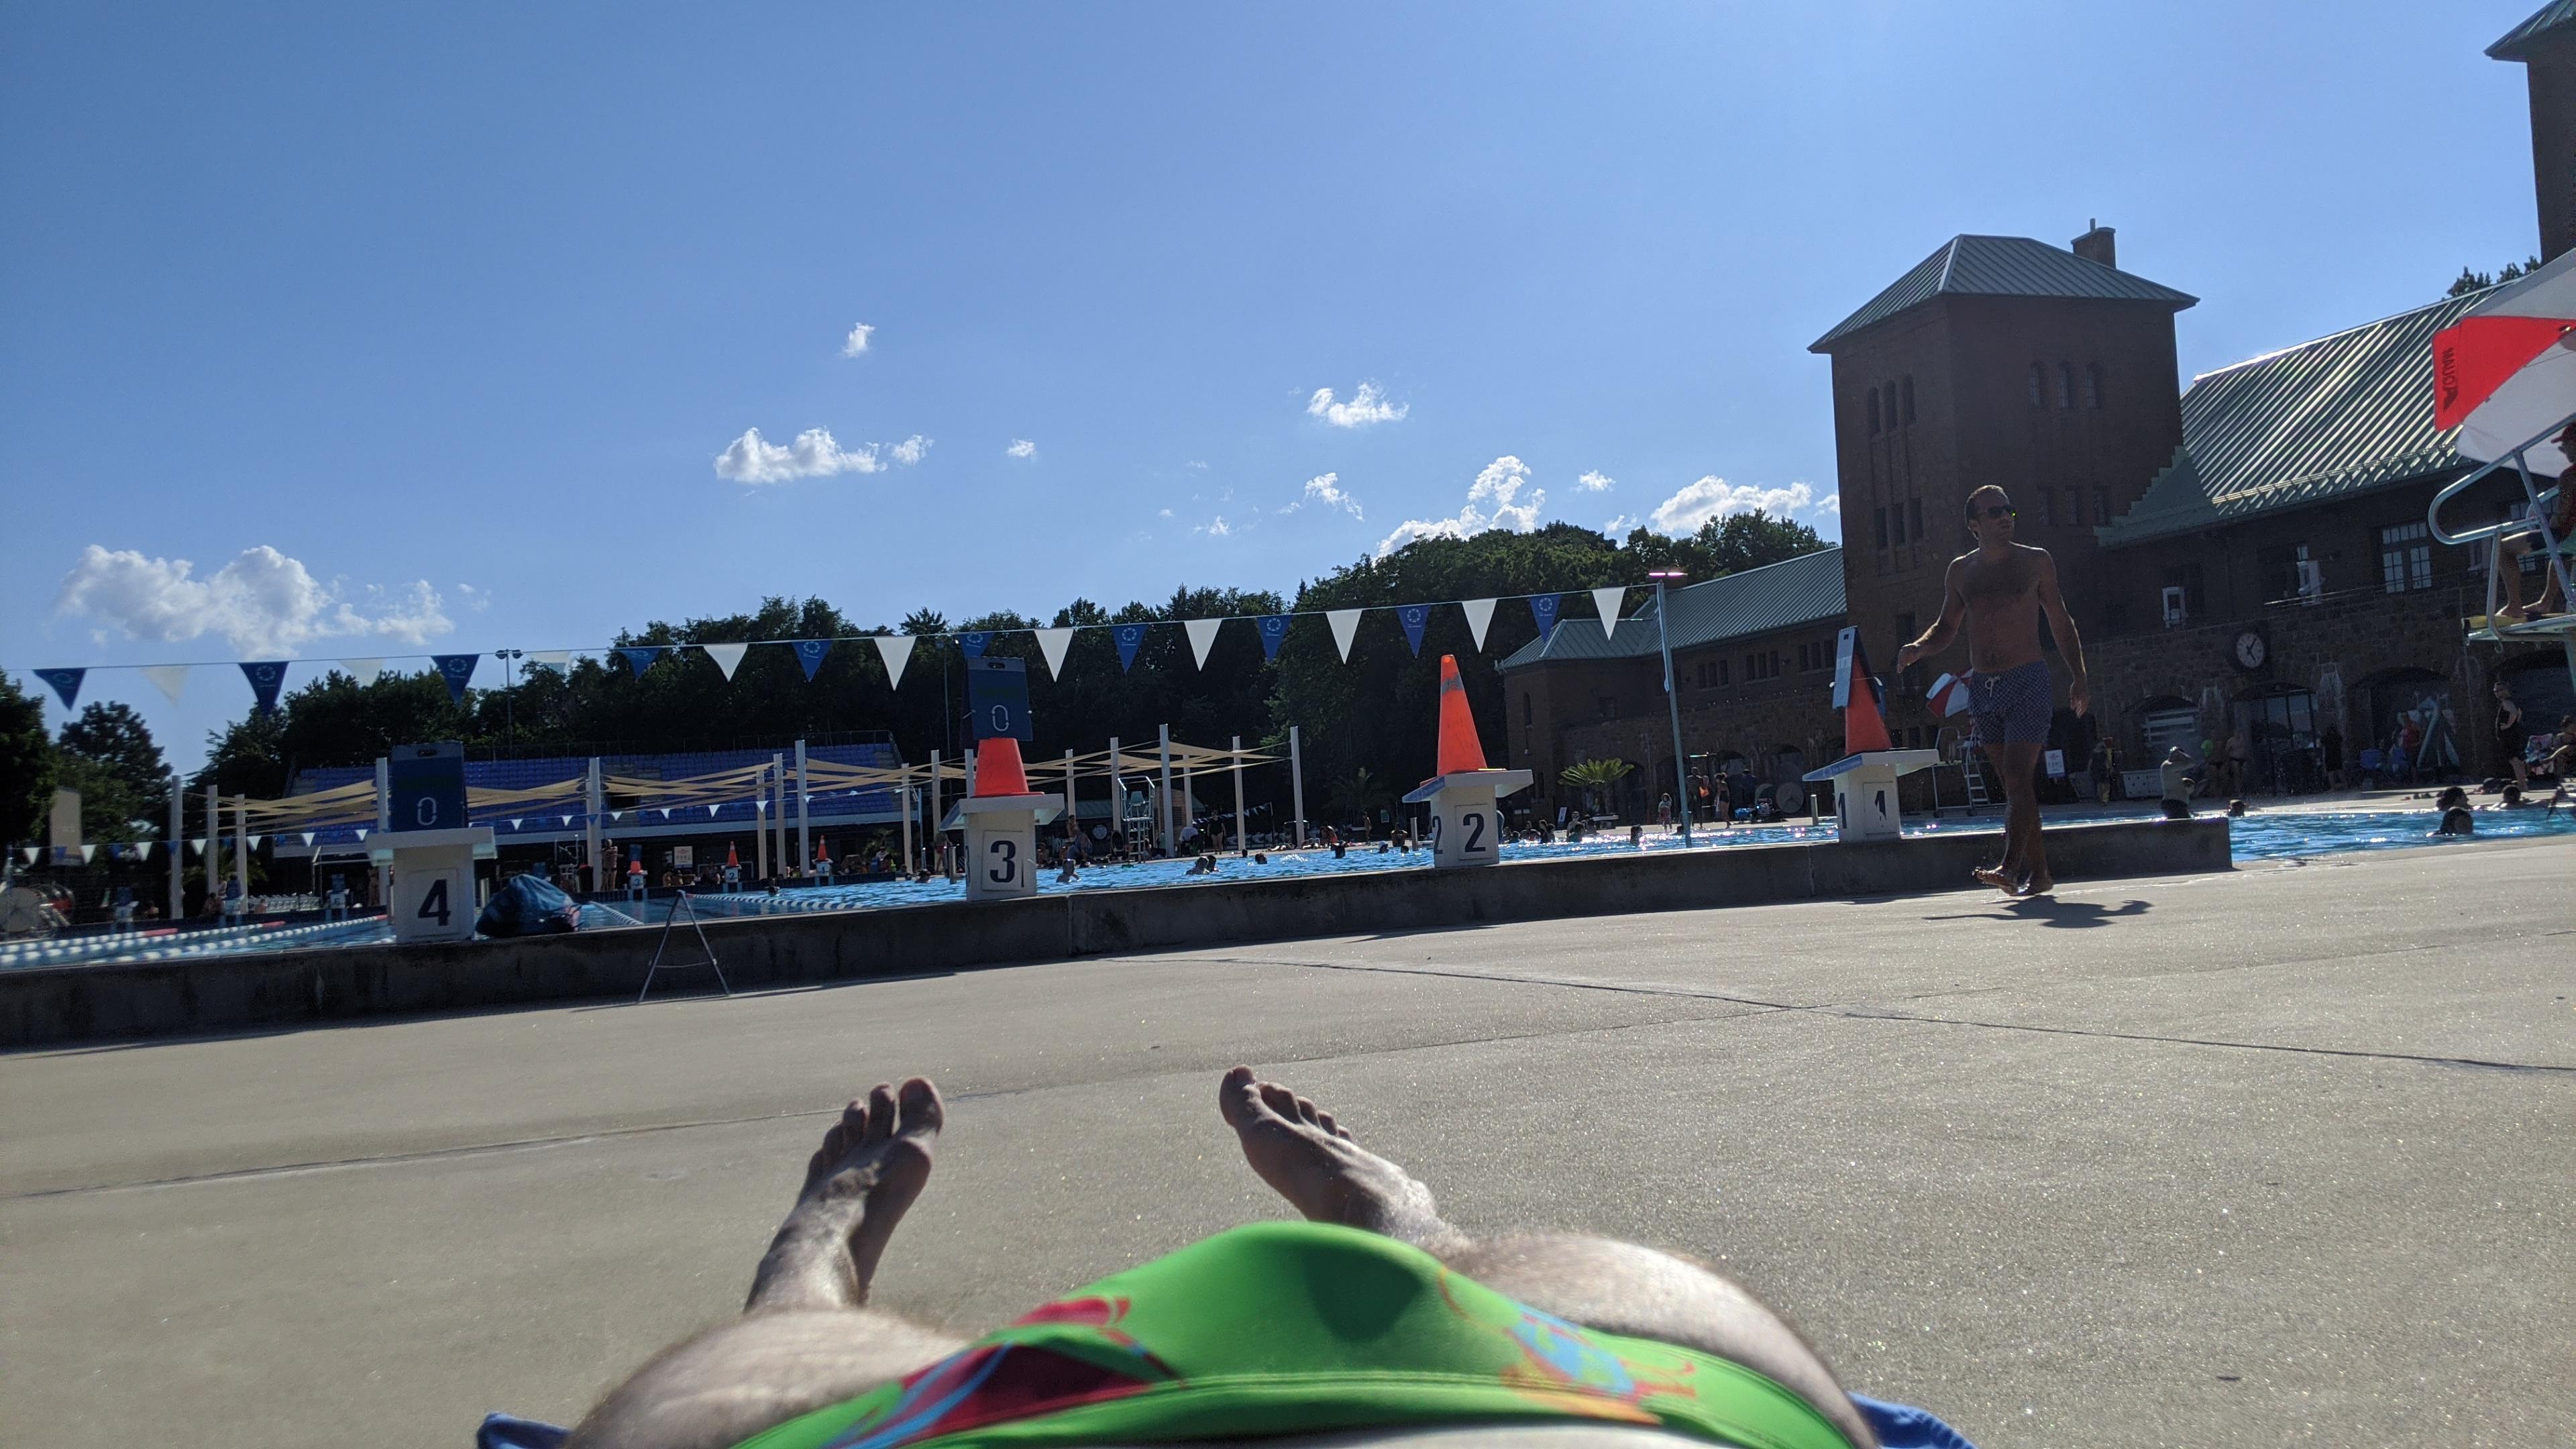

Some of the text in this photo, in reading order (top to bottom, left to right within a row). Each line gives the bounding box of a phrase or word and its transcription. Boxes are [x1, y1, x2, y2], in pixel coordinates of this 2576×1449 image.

[1838, 793, 1847, 828] 1
[1432, 815, 1443, 855] 2
[1462, 813, 1486, 853] 2
[989, 840, 1016, 883] 3
[418, 879, 451, 926] 4
